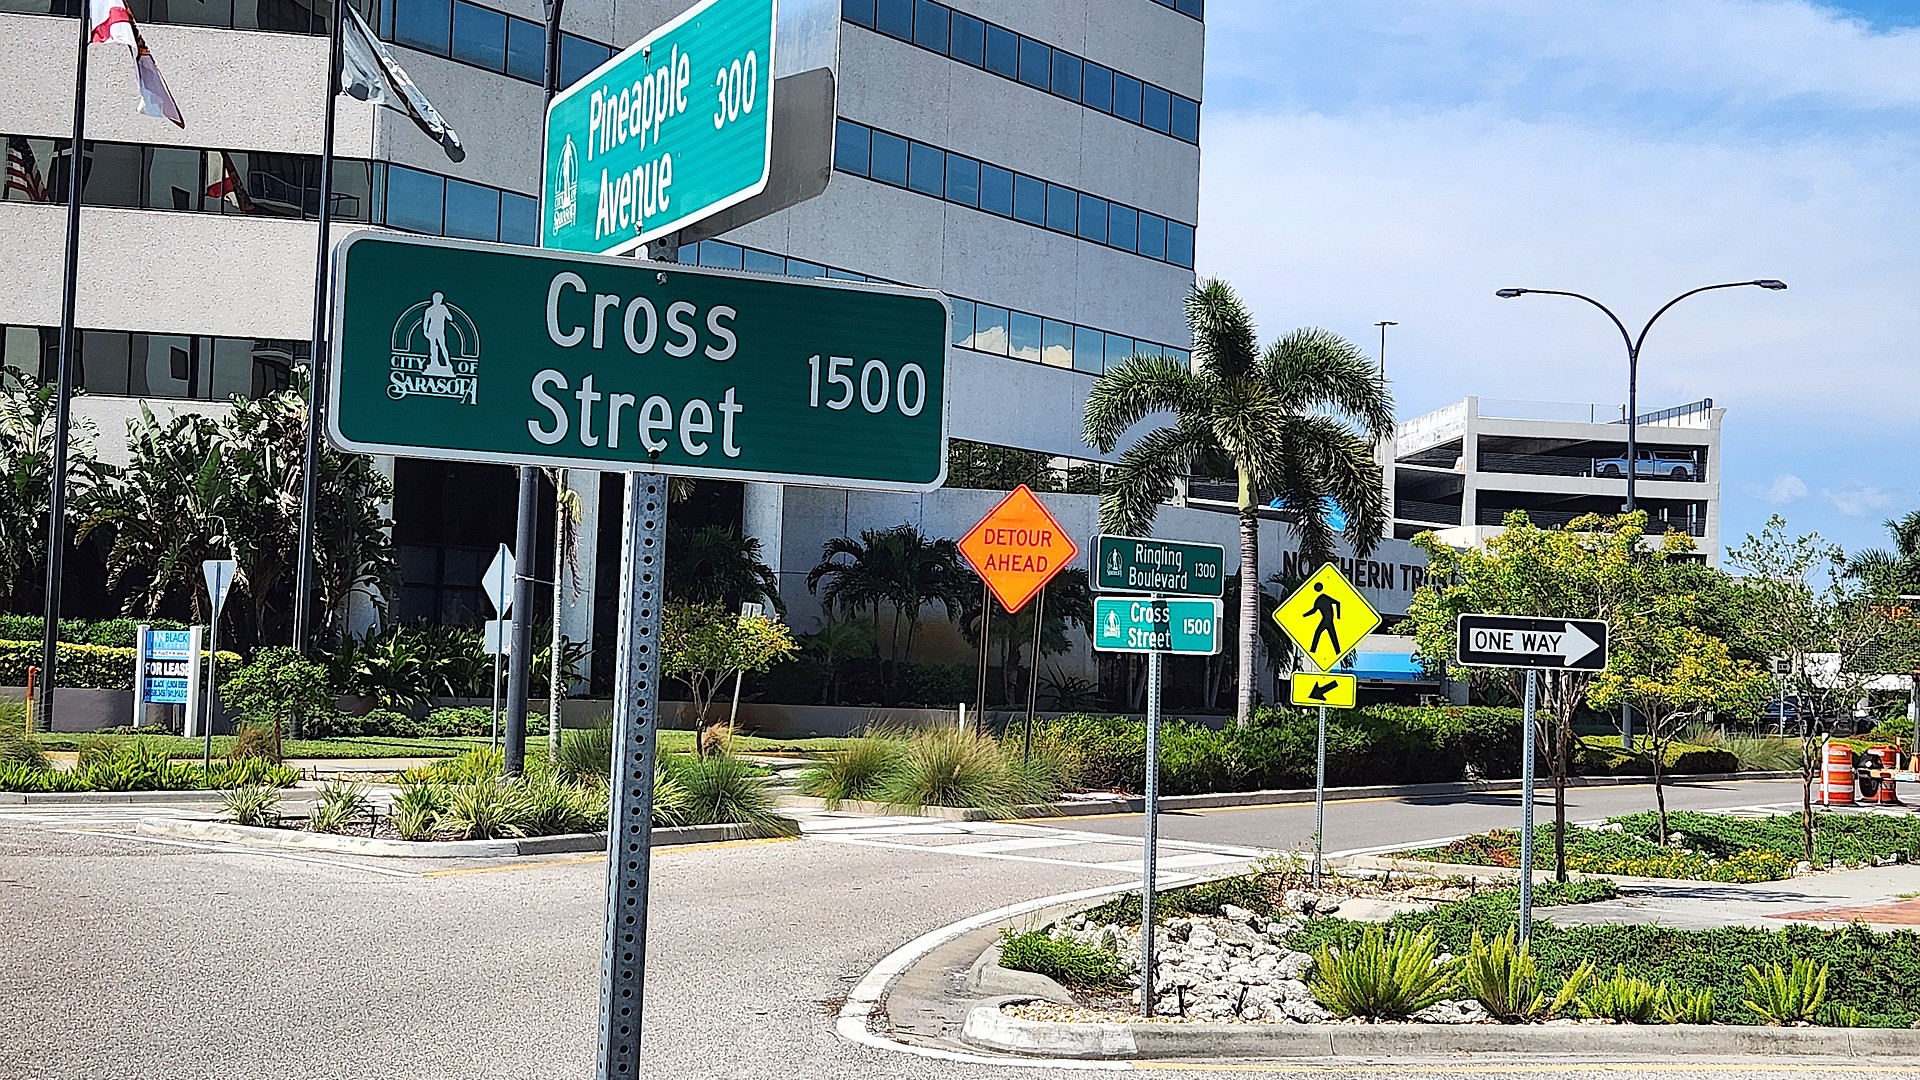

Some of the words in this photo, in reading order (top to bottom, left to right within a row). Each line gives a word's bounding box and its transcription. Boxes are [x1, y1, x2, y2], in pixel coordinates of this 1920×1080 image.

[713, 50, 757, 129] 300
[587, 43, 690, 161] Pineapple
[595, 153, 672, 240] Avenue
[546, 271, 738, 361] Cross
[390, 355, 426, 370] CITY
[458, 361, 478, 374] OF
[386, 371, 478, 405] SARASOTA
[808, 354, 926, 417] 1500
[527, 369, 743, 457] Street
[984, 528, 1053, 548] DETOUR
[984, 553, 1048, 573] AHEAD
[1135, 543, 1183, 572] Ringling
[1128, 566, 1188, 590] Boulevard
[1194, 562, 1216, 578] 1300
[1282, 550, 1394, 590] NOHERN
[1130, 602, 1170, 623] Cross
[1127, 627, 1171, 648] Street
[1183, 618, 1211, 635] 1500
[1475, 630, 1514, 651] ONE
[1522, 633, 1563, 653] WAY
[145, 661, 163, 676] FOR
